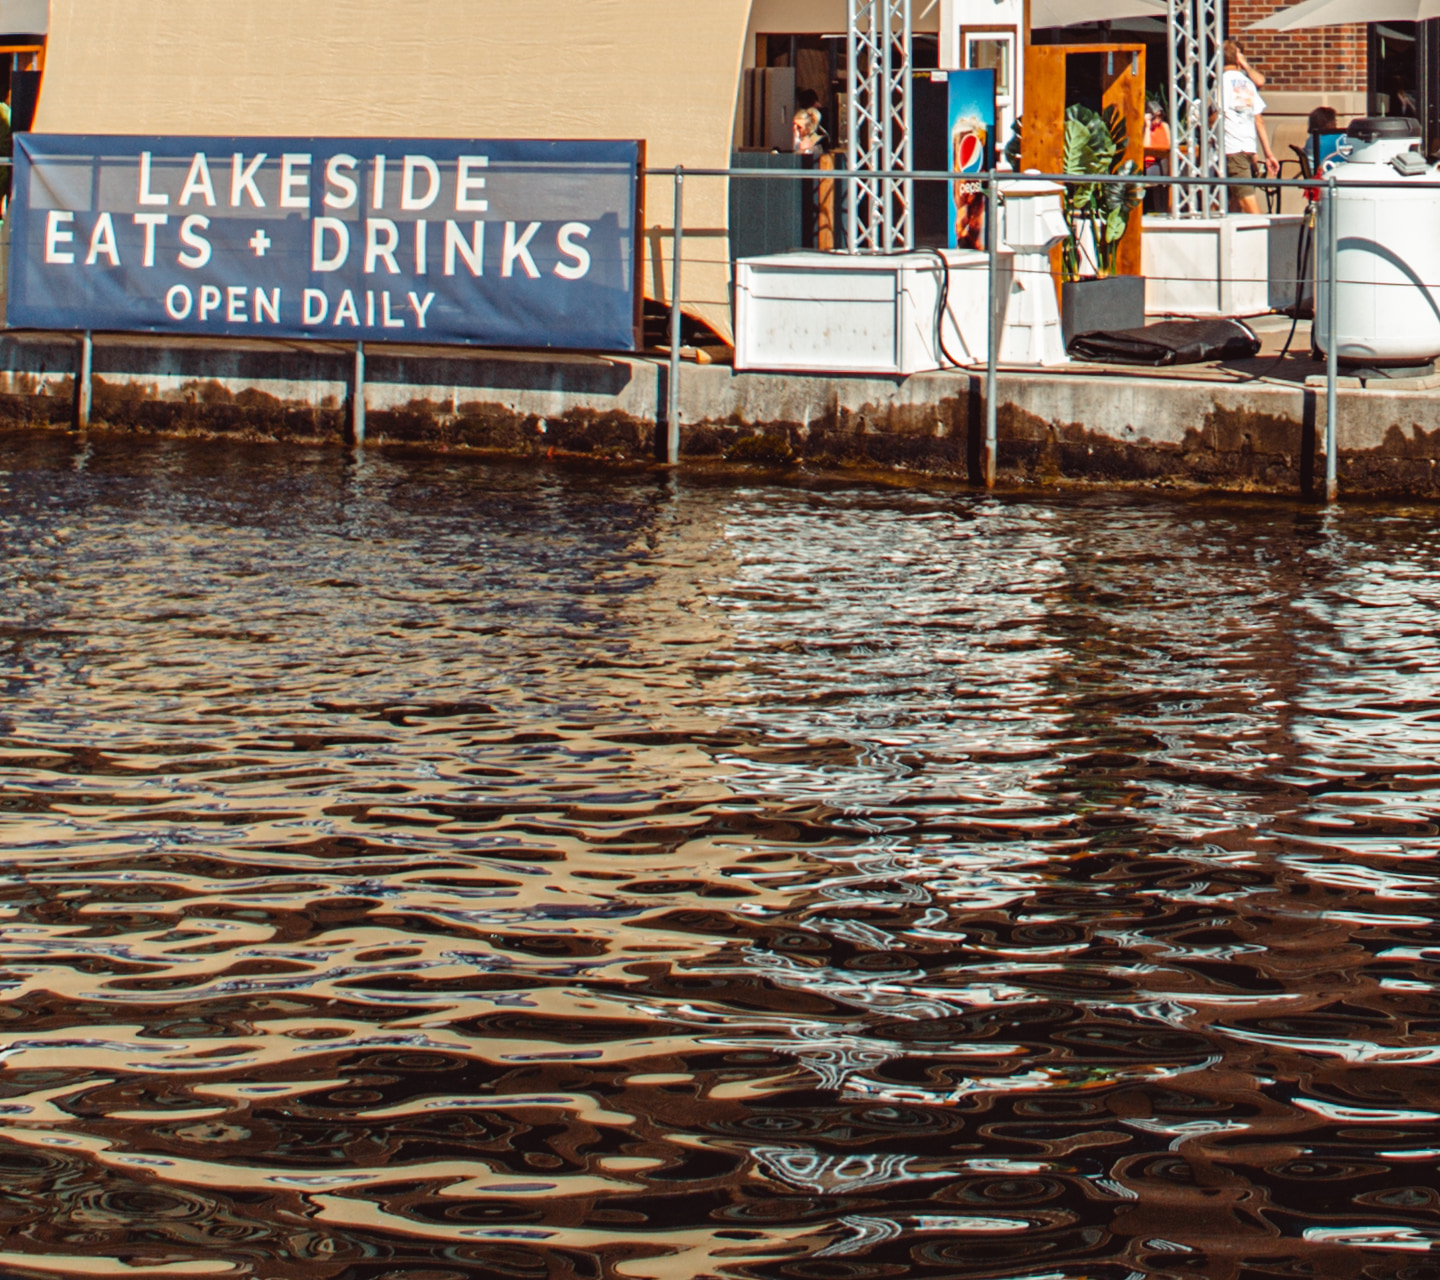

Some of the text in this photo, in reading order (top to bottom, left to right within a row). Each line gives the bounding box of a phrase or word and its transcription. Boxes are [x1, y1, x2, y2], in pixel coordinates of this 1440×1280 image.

[138, 151, 490, 213] LAKESIDE
[45, 210, 592, 280] EATS + DRINKS
[165, 284, 436, 328] OPEN DAILY
